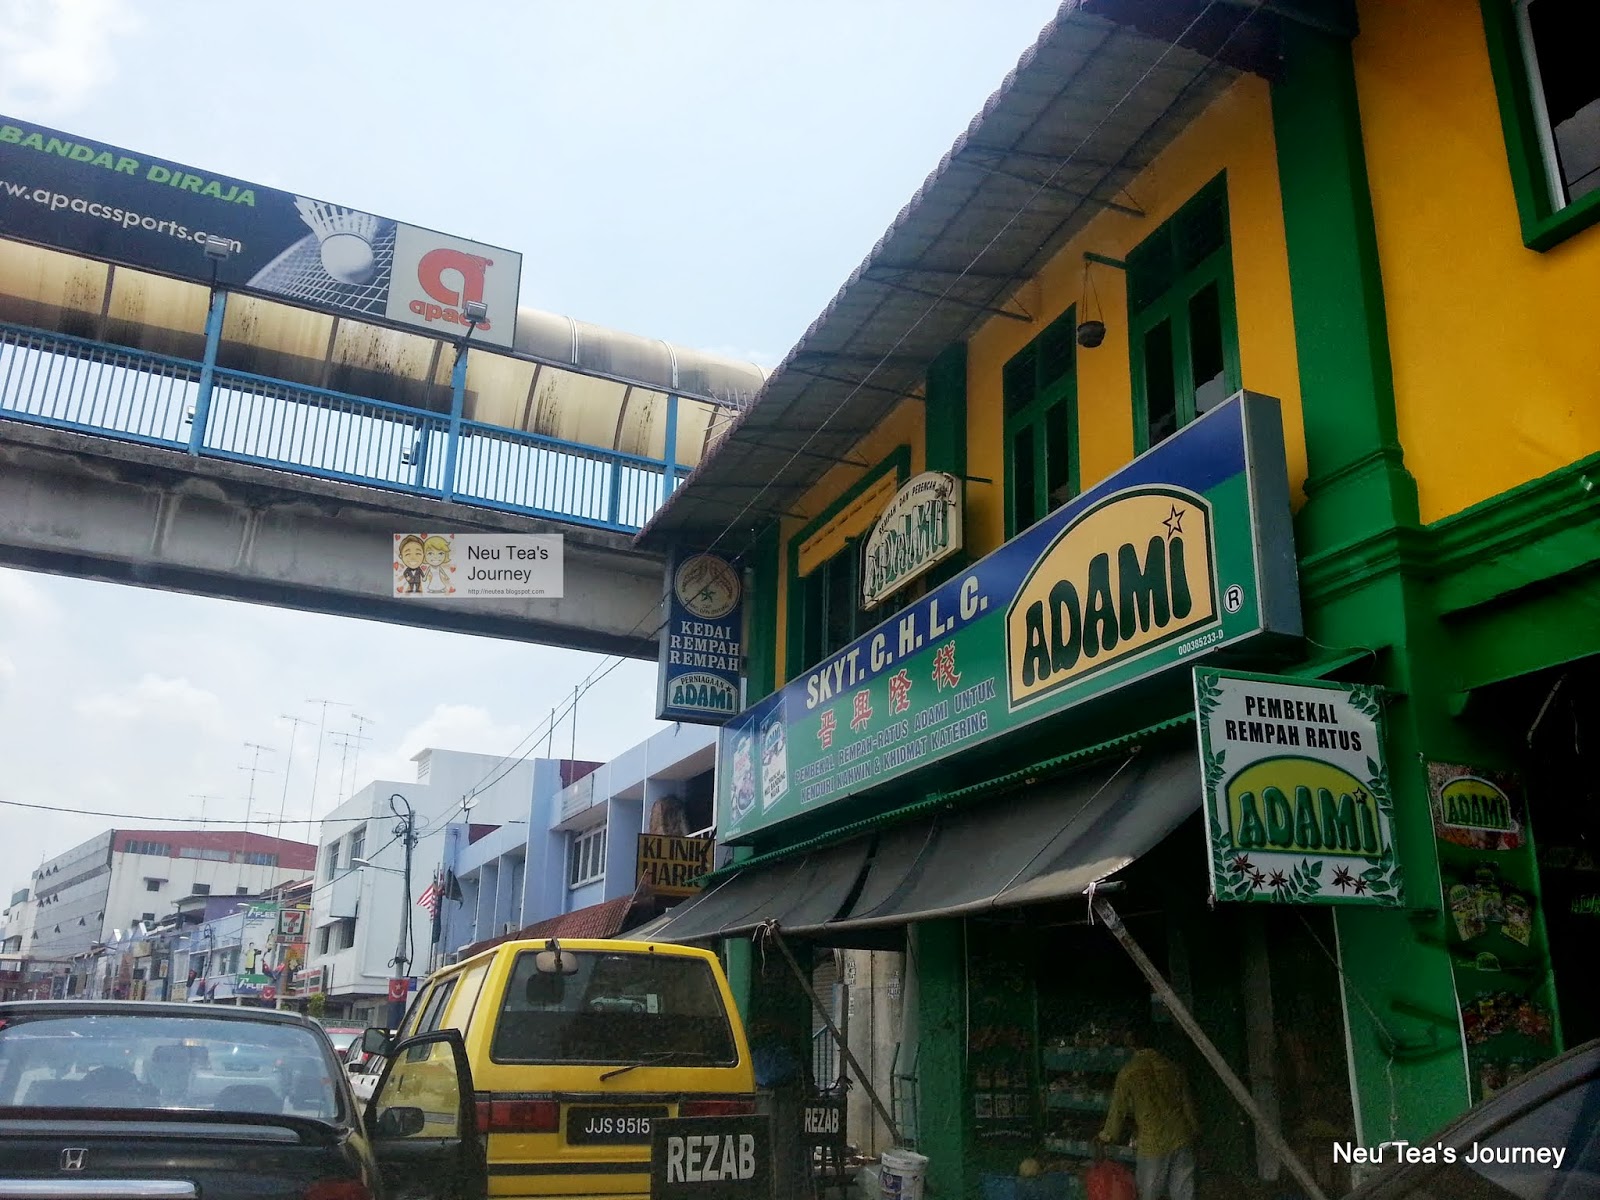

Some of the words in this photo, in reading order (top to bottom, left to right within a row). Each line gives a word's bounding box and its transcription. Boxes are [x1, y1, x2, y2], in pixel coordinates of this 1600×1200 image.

[0, 125, 140, 176] BANDAR
[146, 165, 256, 207] DIRAJA
[0, 180, 242, 254] w.apacssports.cm
[1022, 535, 1193, 688] ADAMI
[670, 634, 740, 656] REMPAH
[681, 620, 732, 640] KEDAI
[806, 648, 865, 710] SKYT.
[870, 632, 893, 673] C.
[898, 613, 923, 658] H.
[929, 599, 954, 640] L.
[960, 575, 989, 621] C.
[1178, 629, 1224, 656] 000385233-D
[669, 650, 739, 672] REMPAH
[672, 683, 733, 711] ADAMI
[681, 675, 725, 689] PERNIAGAAN
[1245, 695, 1339, 725] PEMBEKAL
[795, 754, 835, 786] PEMBEKAL
[838, 718, 909, 767] REMPAH-RATUS
[914, 700, 949, 733] ADAMI
[954, 676, 996, 714] UNTUK
[1225, 719, 1300, 747] REMPAH
[1305, 727, 1362, 752] RATUS
[800, 774, 835, 805] KENDURI
[837, 761, 871, 790] KAHWIN
[874, 757, 881, 775] &
[883, 735, 927, 772] KHIDMAT
[931, 708, 989, 751] KATERING
[1238, 785, 1378, 854] ADAMI
[1446, 793, 1510, 830] ADAMI
[643, 836, 711, 863] KLINIK
[585, 1117, 613, 1134] JJS
[616, 1117, 650, 1134] 9515
[804, 1107, 839, 1134] REZAB
[667, 1133, 756, 1184] REZAB
